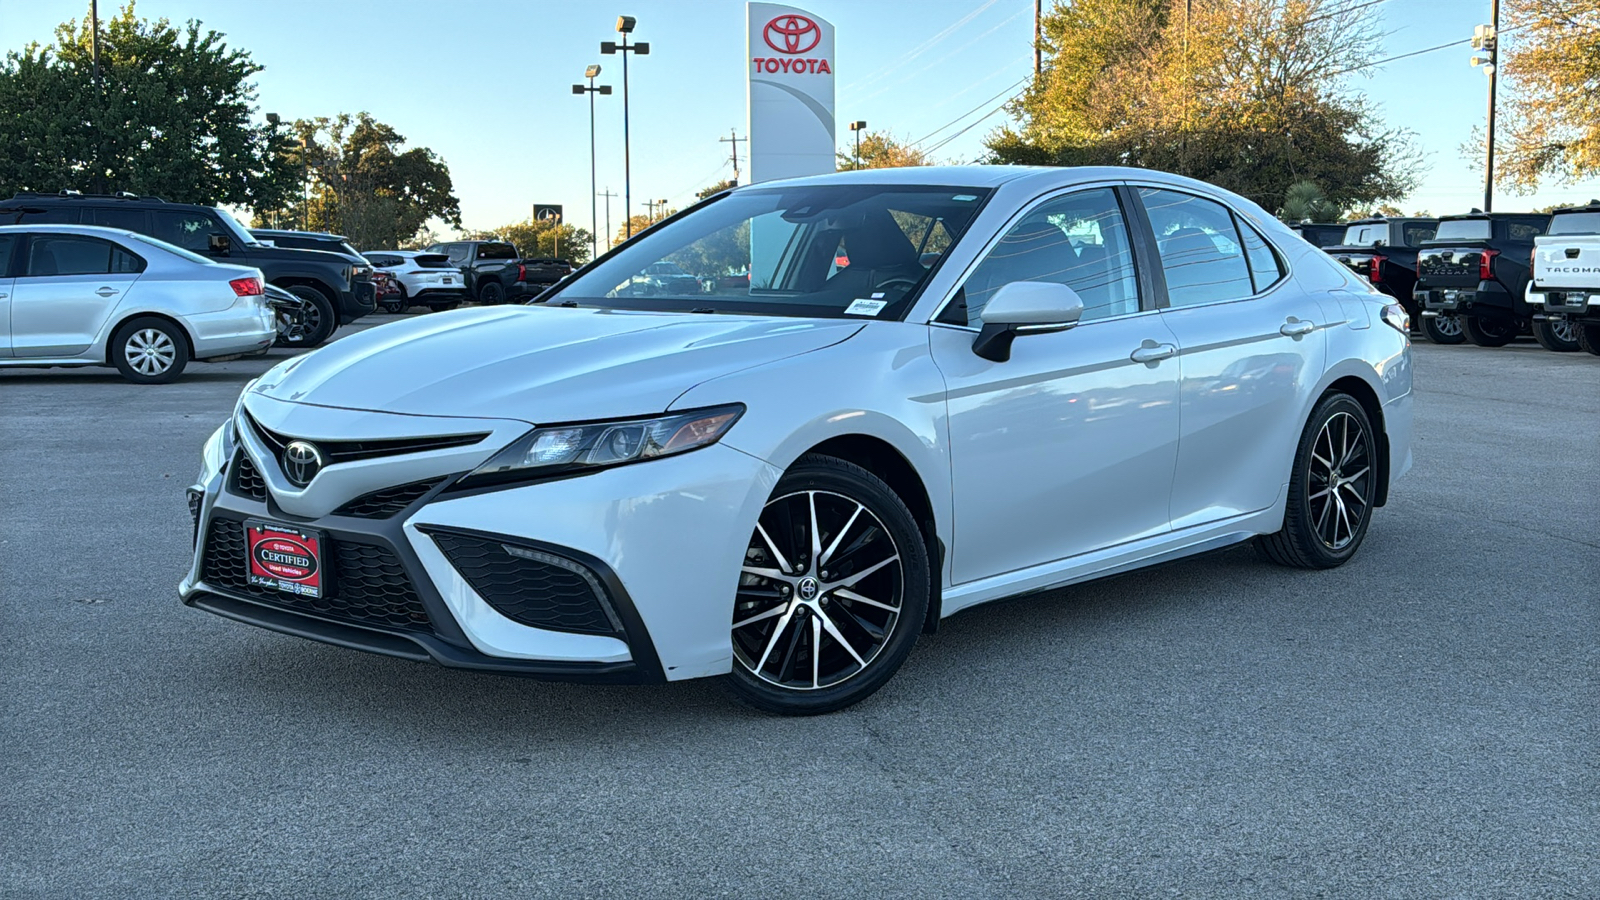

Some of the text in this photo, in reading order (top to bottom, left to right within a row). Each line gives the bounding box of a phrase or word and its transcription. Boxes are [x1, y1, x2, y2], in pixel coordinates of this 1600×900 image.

[753, 58, 831, 74] TOYOTA
[269, 564, 302, 576] Used Vehicles
[279, 582, 294, 590] TOYOTA
